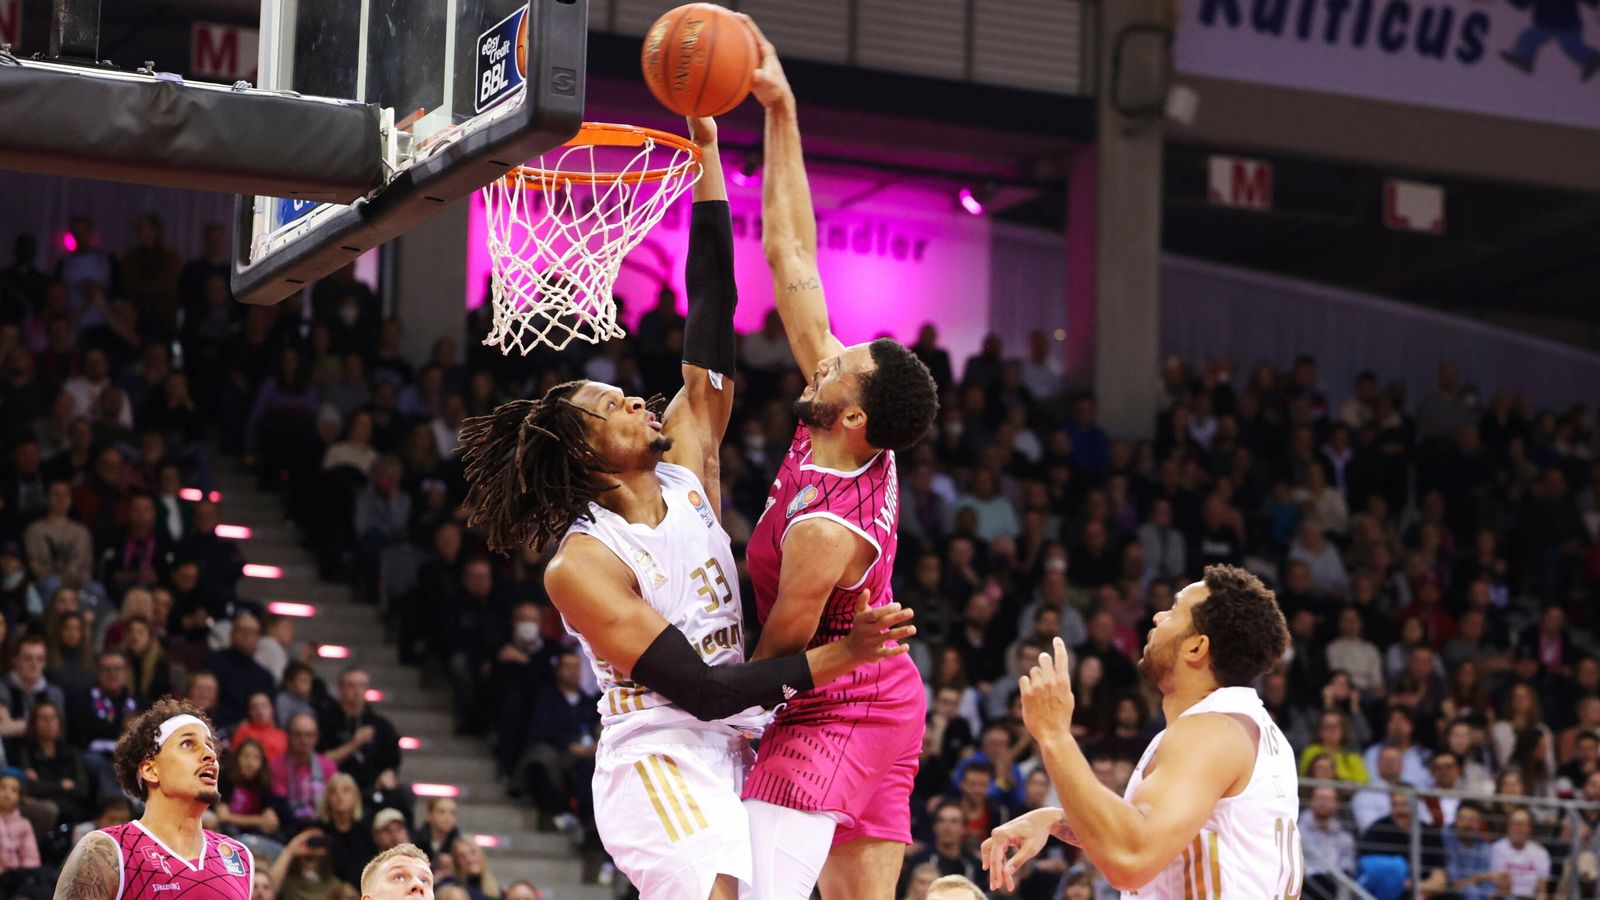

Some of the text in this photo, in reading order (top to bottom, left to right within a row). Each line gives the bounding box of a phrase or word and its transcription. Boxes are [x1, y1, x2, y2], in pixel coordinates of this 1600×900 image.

[194, 24, 239, 75] M
[489, 40, 511, 64] Credit
[480, 59, 509, 103] BBL
[1230, 158, 1271, 211] M
[689, 557, 732, 613] 33
[152, 882, 181, 893] SPALDING
